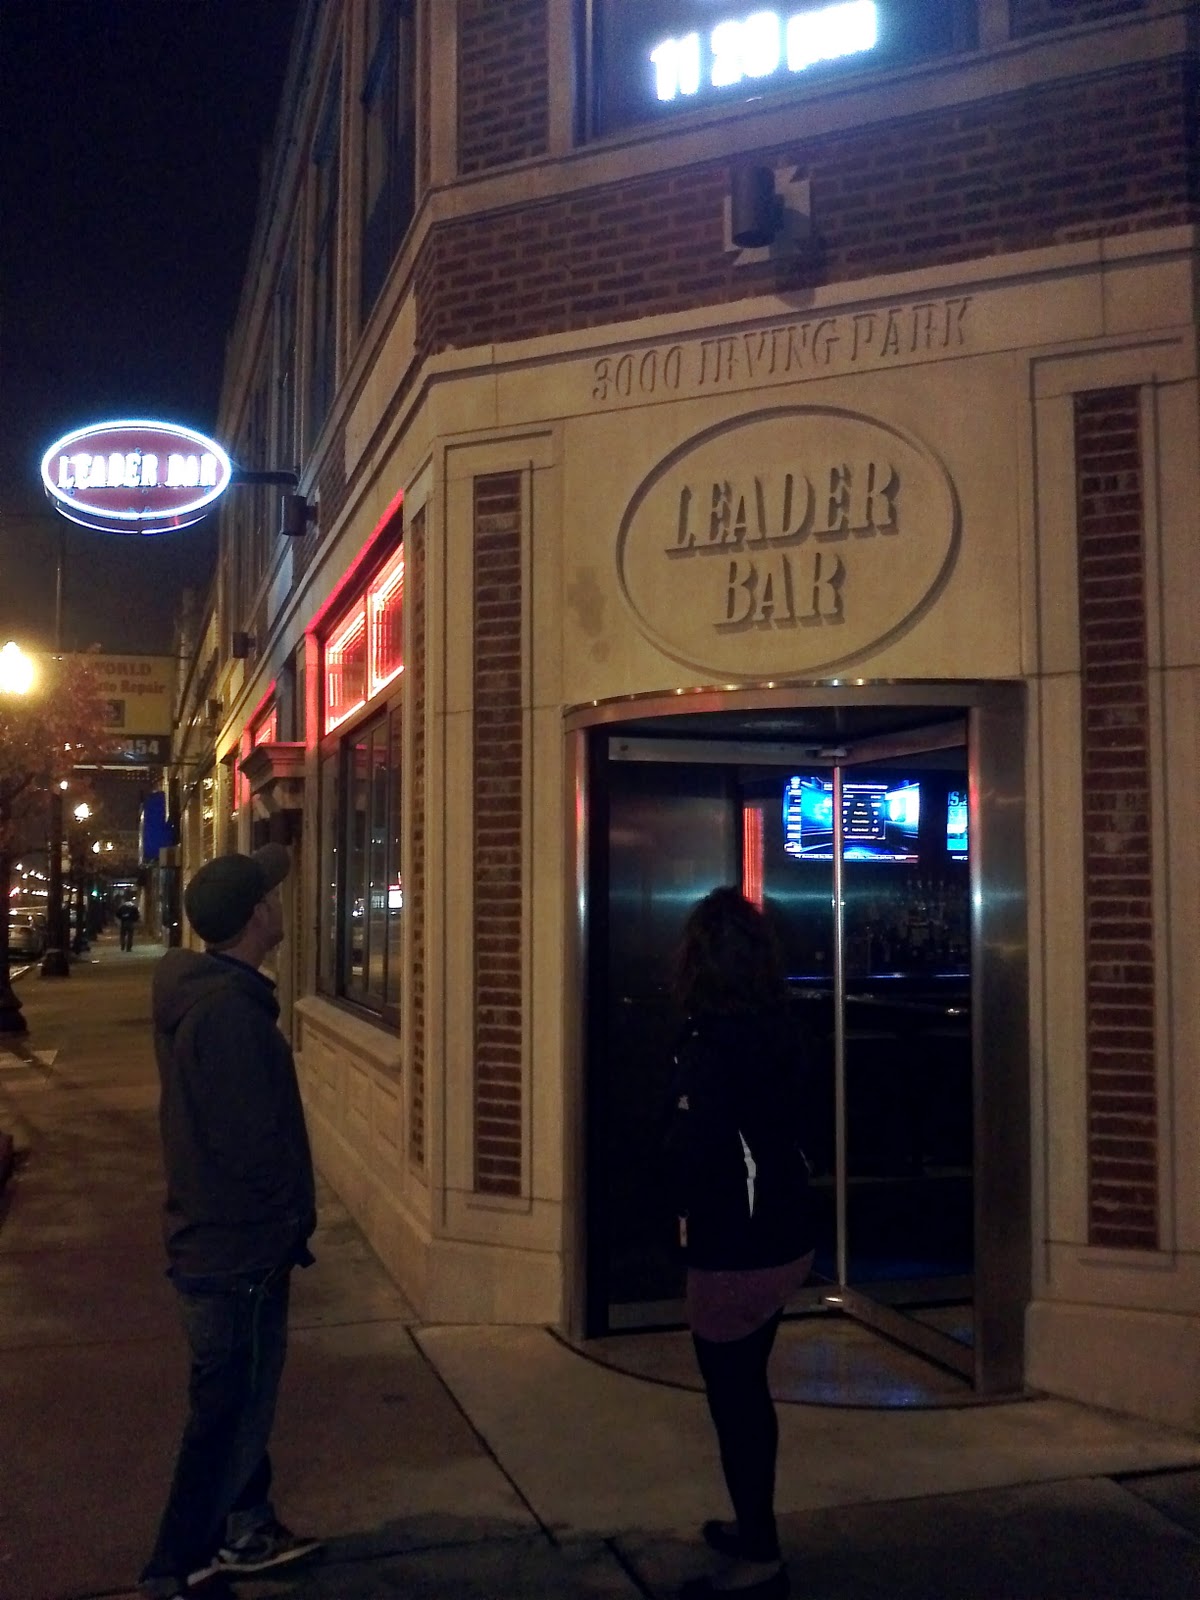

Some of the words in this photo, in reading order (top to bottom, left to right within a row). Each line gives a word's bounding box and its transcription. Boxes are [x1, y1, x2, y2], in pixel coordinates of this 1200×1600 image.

[592, 336, 683, 400] 3000
[698, 318, 842, 386] IRVING
[850, 297, 973, 361] PARK
[57, 453, 159, 489] LEADER
[666, 462, 900, 559] LEADER
[713, 552, 847, 635] BAR
